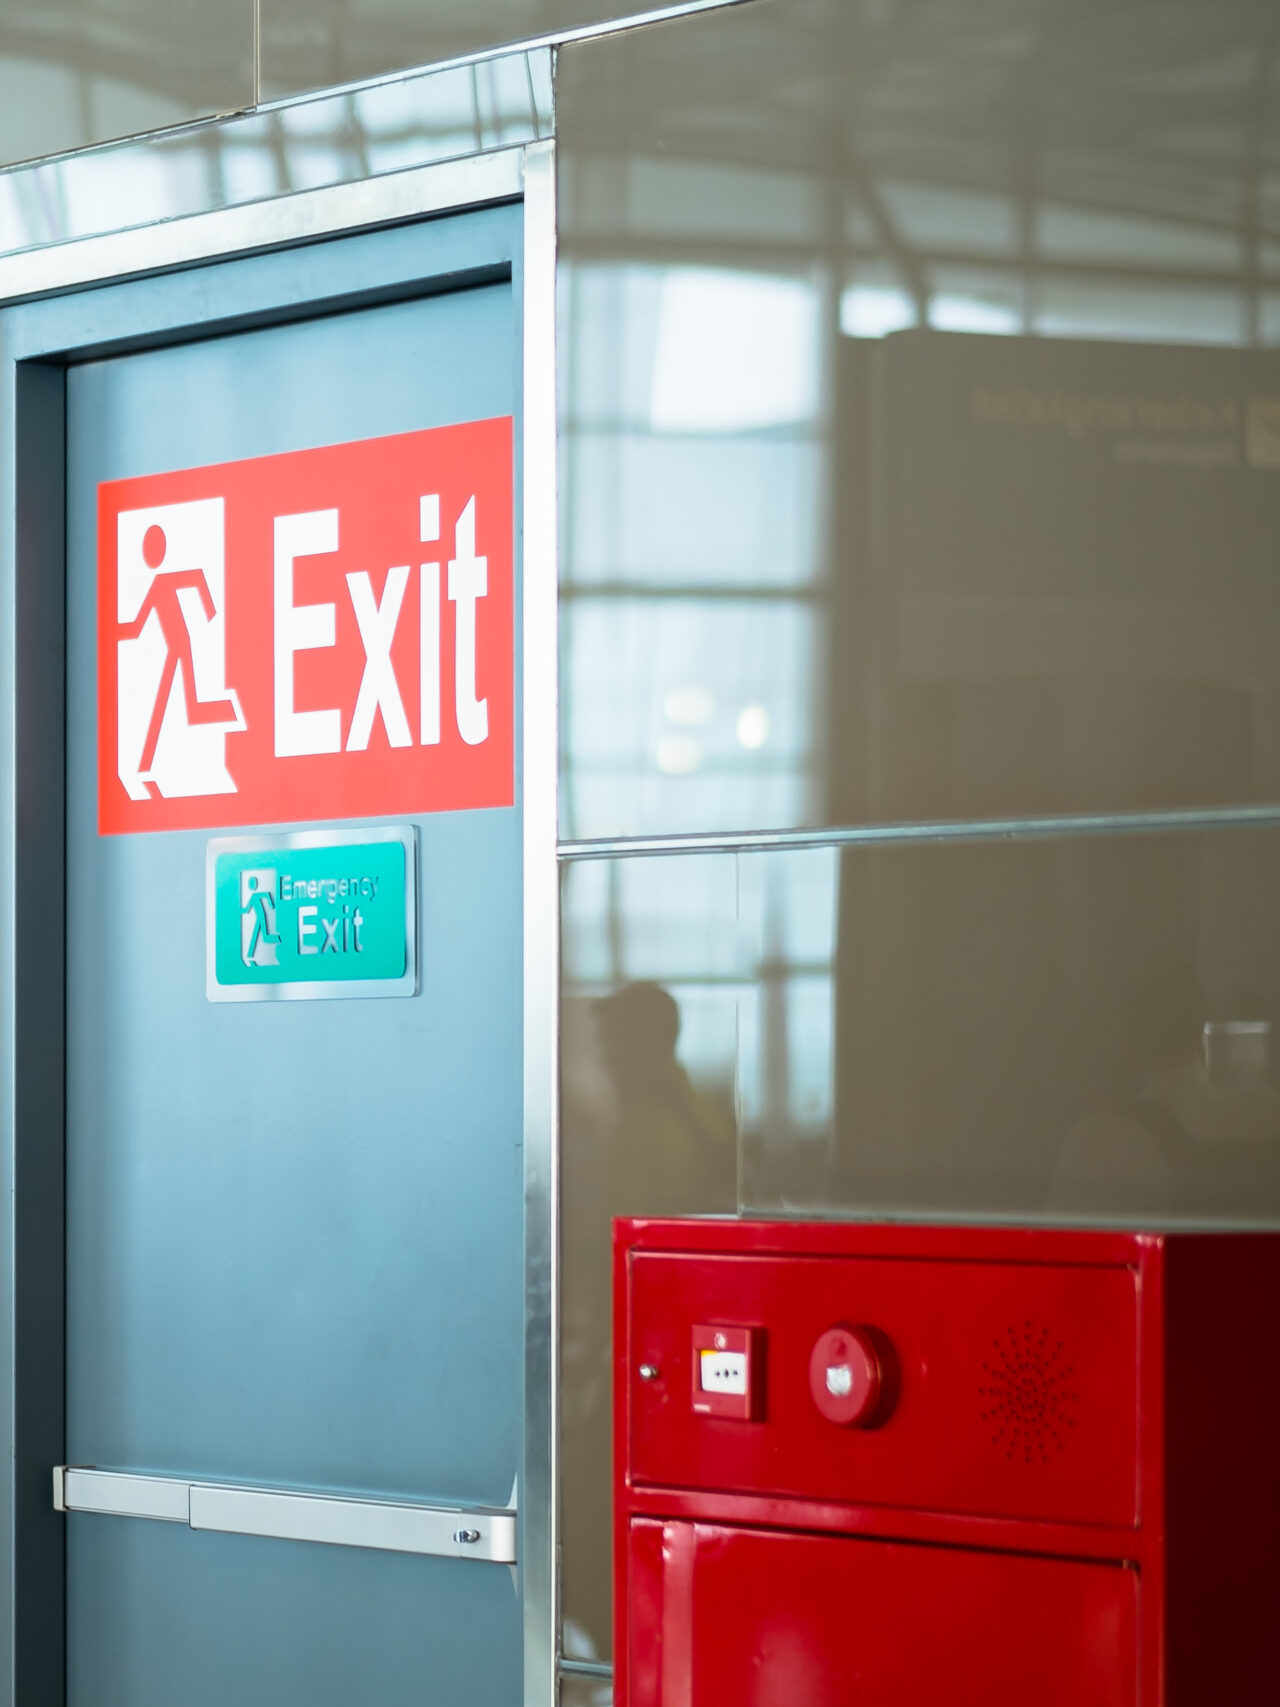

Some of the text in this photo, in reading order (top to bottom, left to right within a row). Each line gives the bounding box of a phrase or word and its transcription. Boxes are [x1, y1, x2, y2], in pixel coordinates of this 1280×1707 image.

[273, 493, 489, 758] Exit
[279, 875, 380, 904] Emergency
[297, 904, 364, 955] Exit
